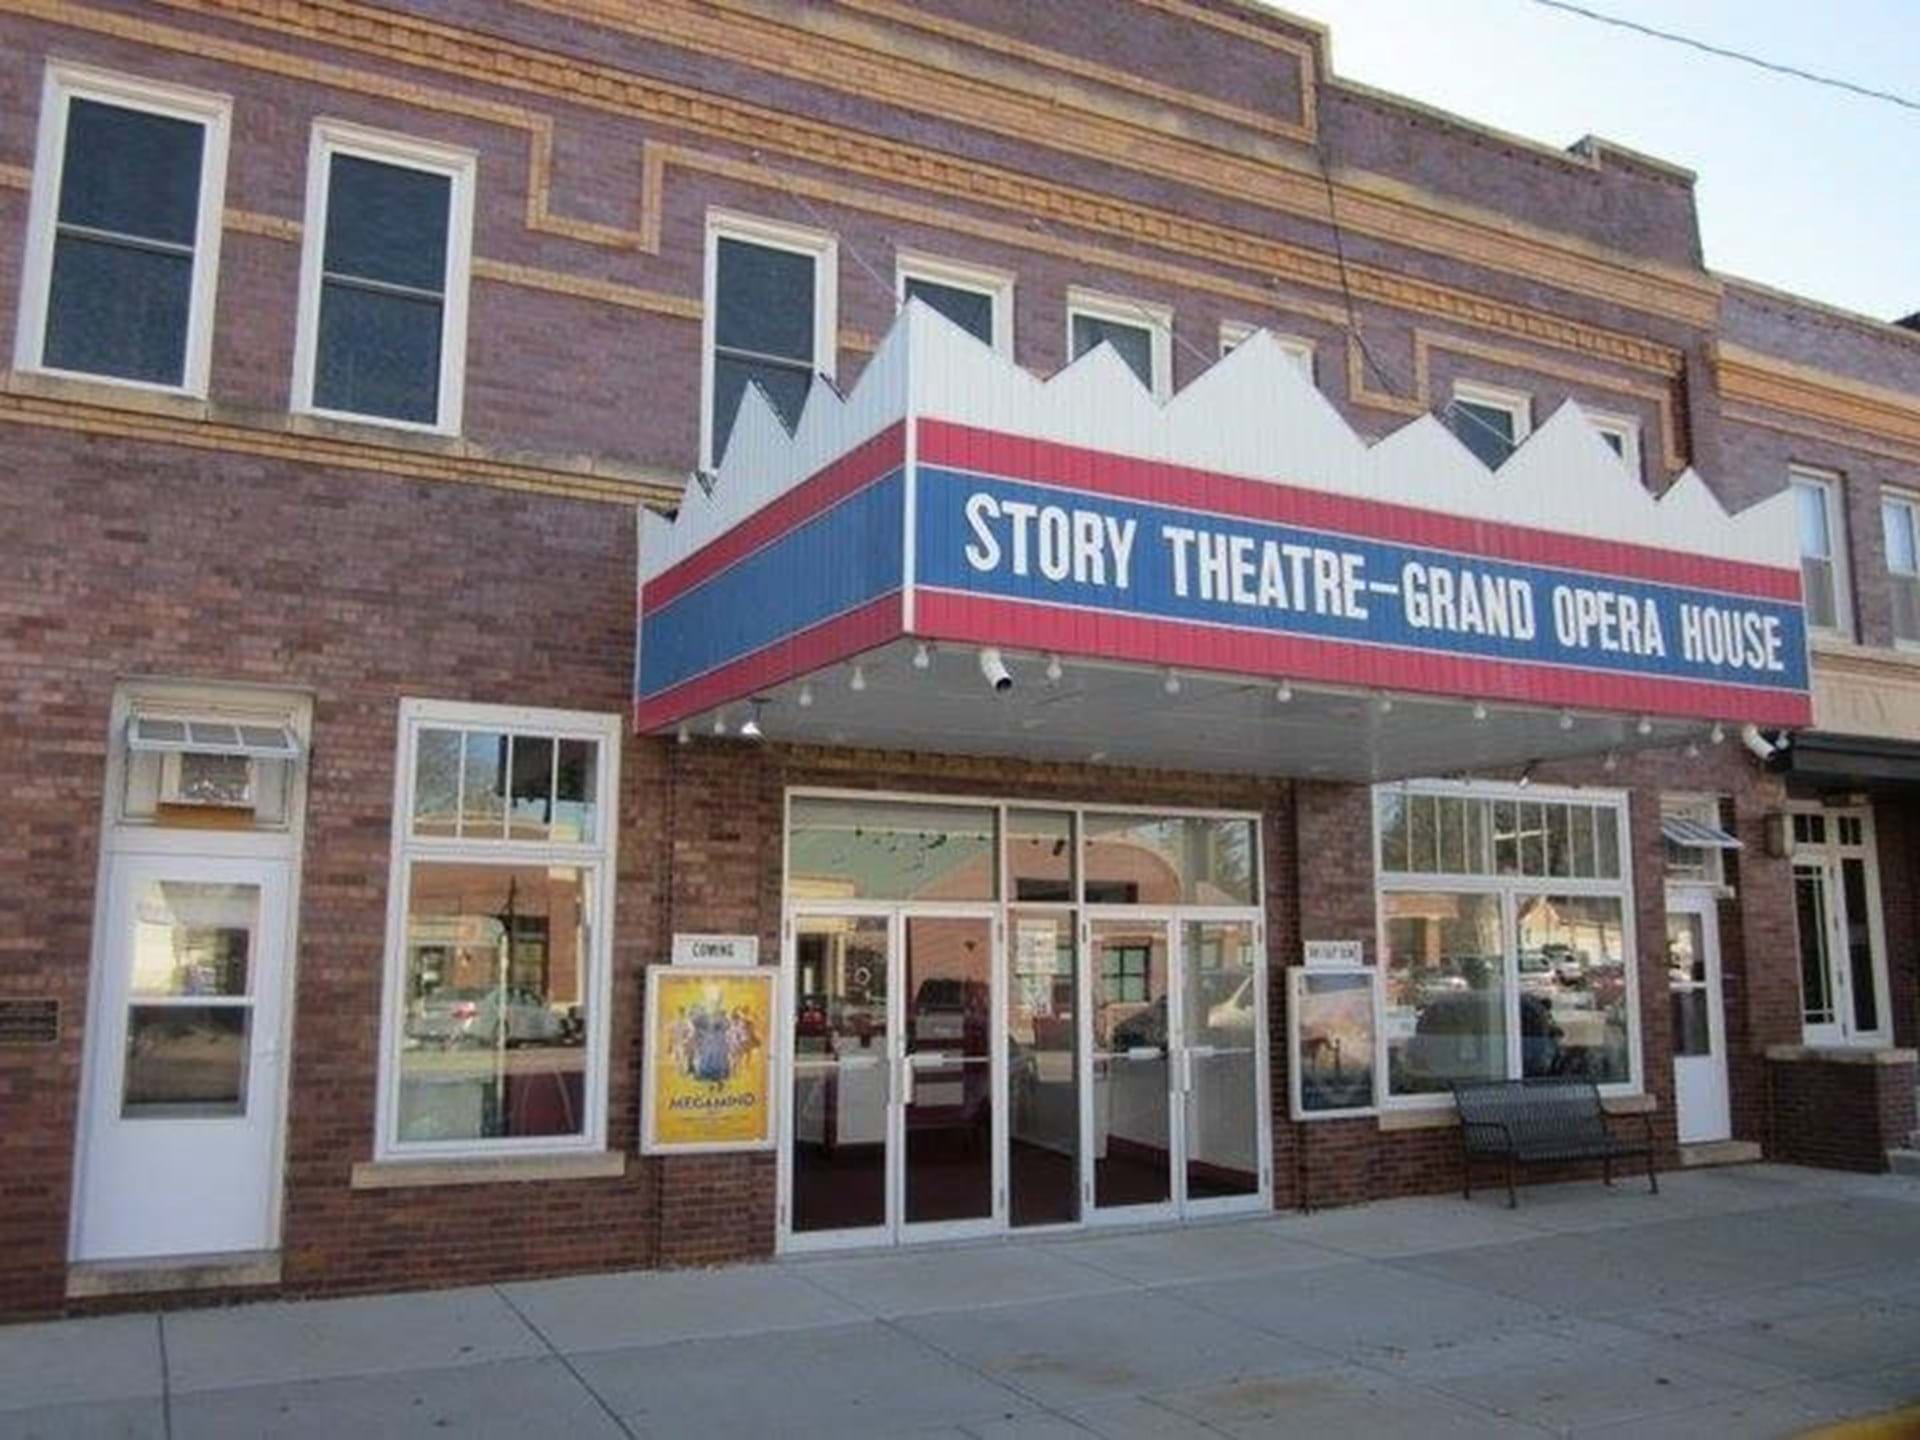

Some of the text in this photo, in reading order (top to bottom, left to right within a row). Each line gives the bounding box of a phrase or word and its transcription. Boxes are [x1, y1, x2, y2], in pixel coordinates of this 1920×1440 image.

[964, 492, 1137, 589] STORY
[1552, 585, 1667, 657] OPERA
[1680, 603, 1784, 672] HOUSE
[669, 1092, 756, 1110] MEGAMIND
